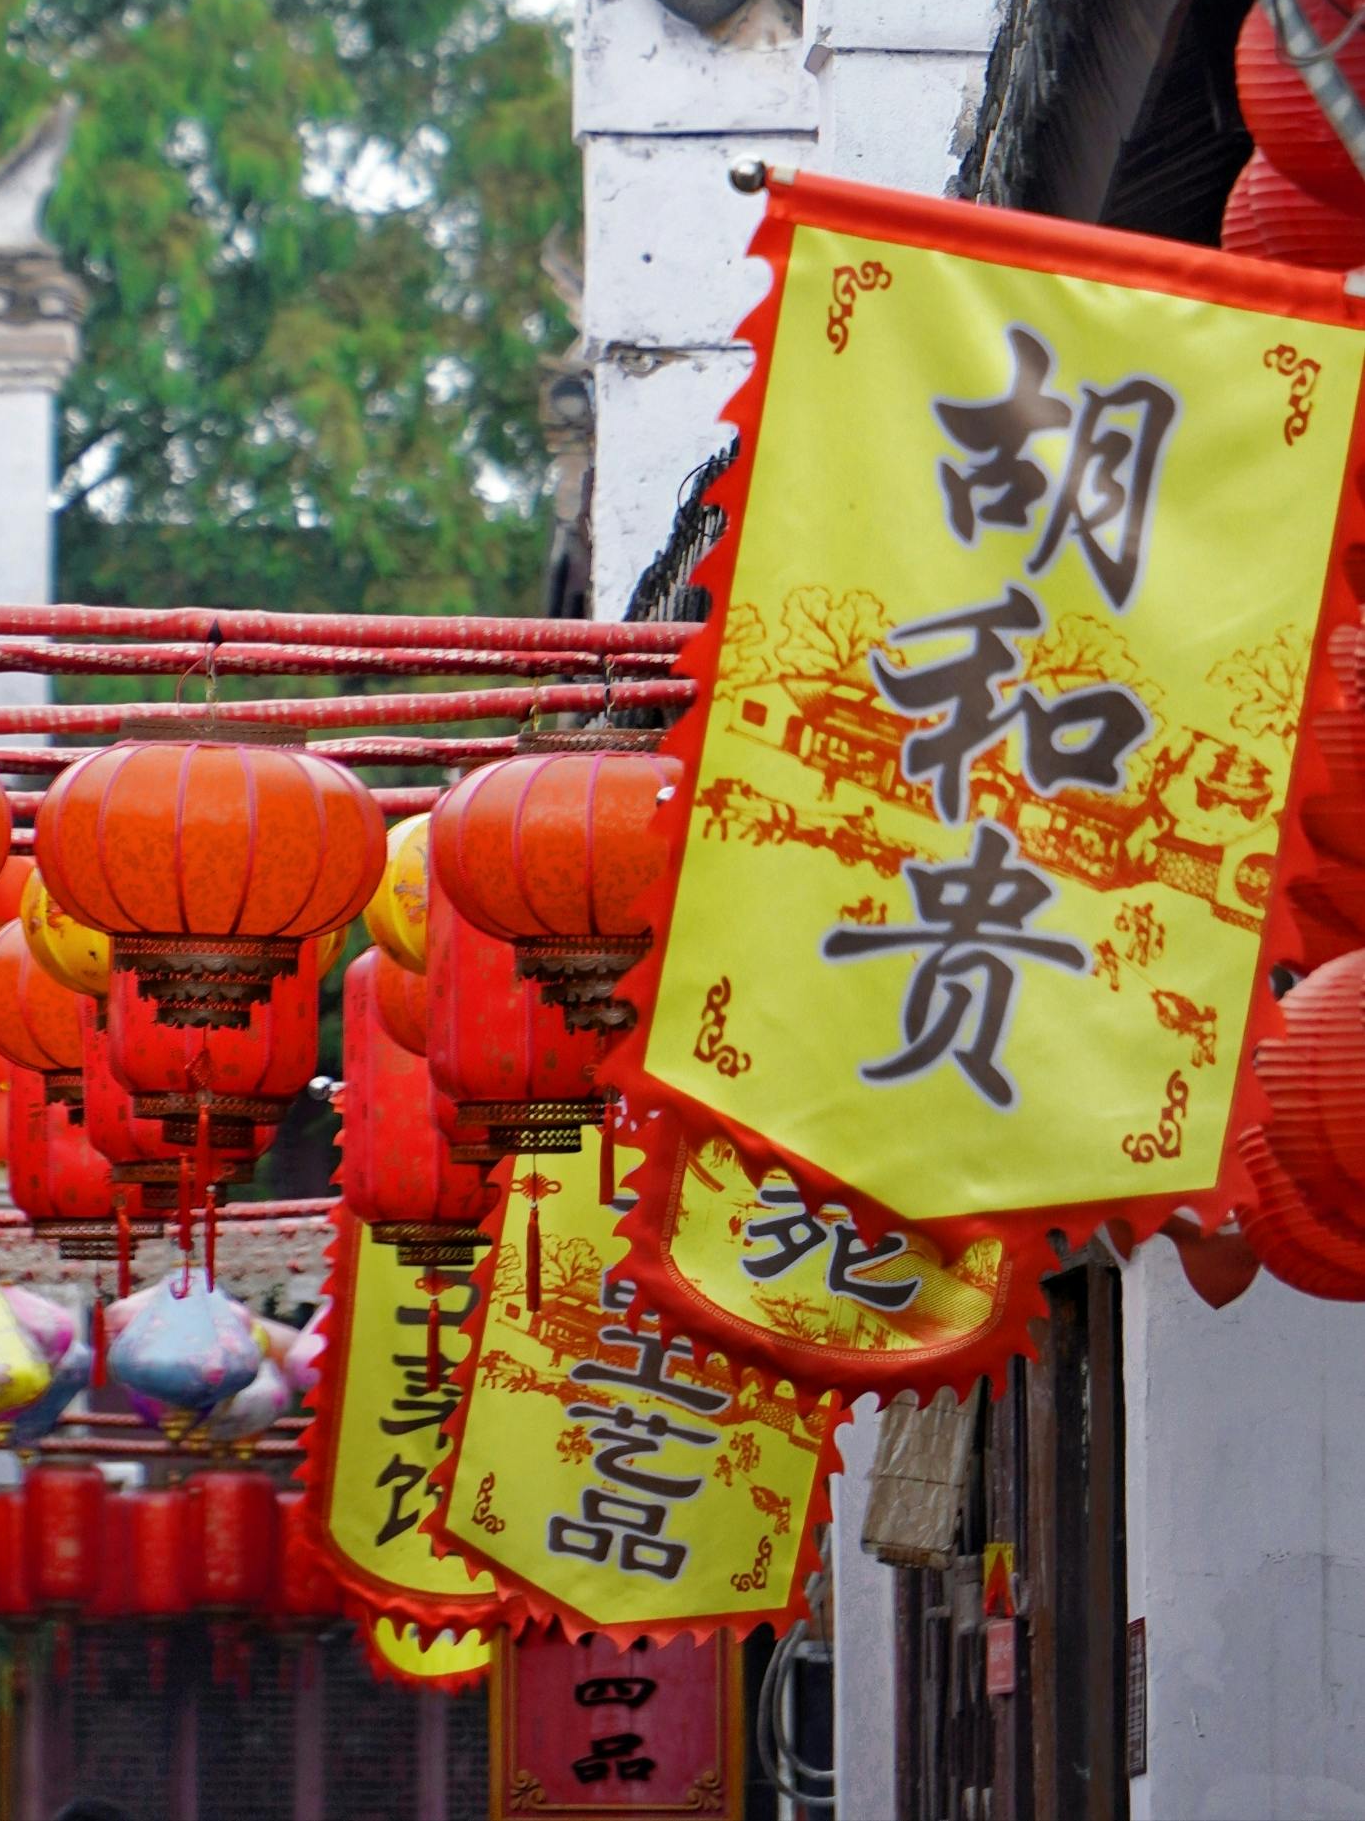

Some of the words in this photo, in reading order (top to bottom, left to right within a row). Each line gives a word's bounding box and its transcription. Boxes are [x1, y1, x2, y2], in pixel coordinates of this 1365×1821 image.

[824, 325, 1176, 1110] 胡和贵
[548, 1194, 730, 1582] 工艺品
[570, 1632, 658, 1784] 四品
